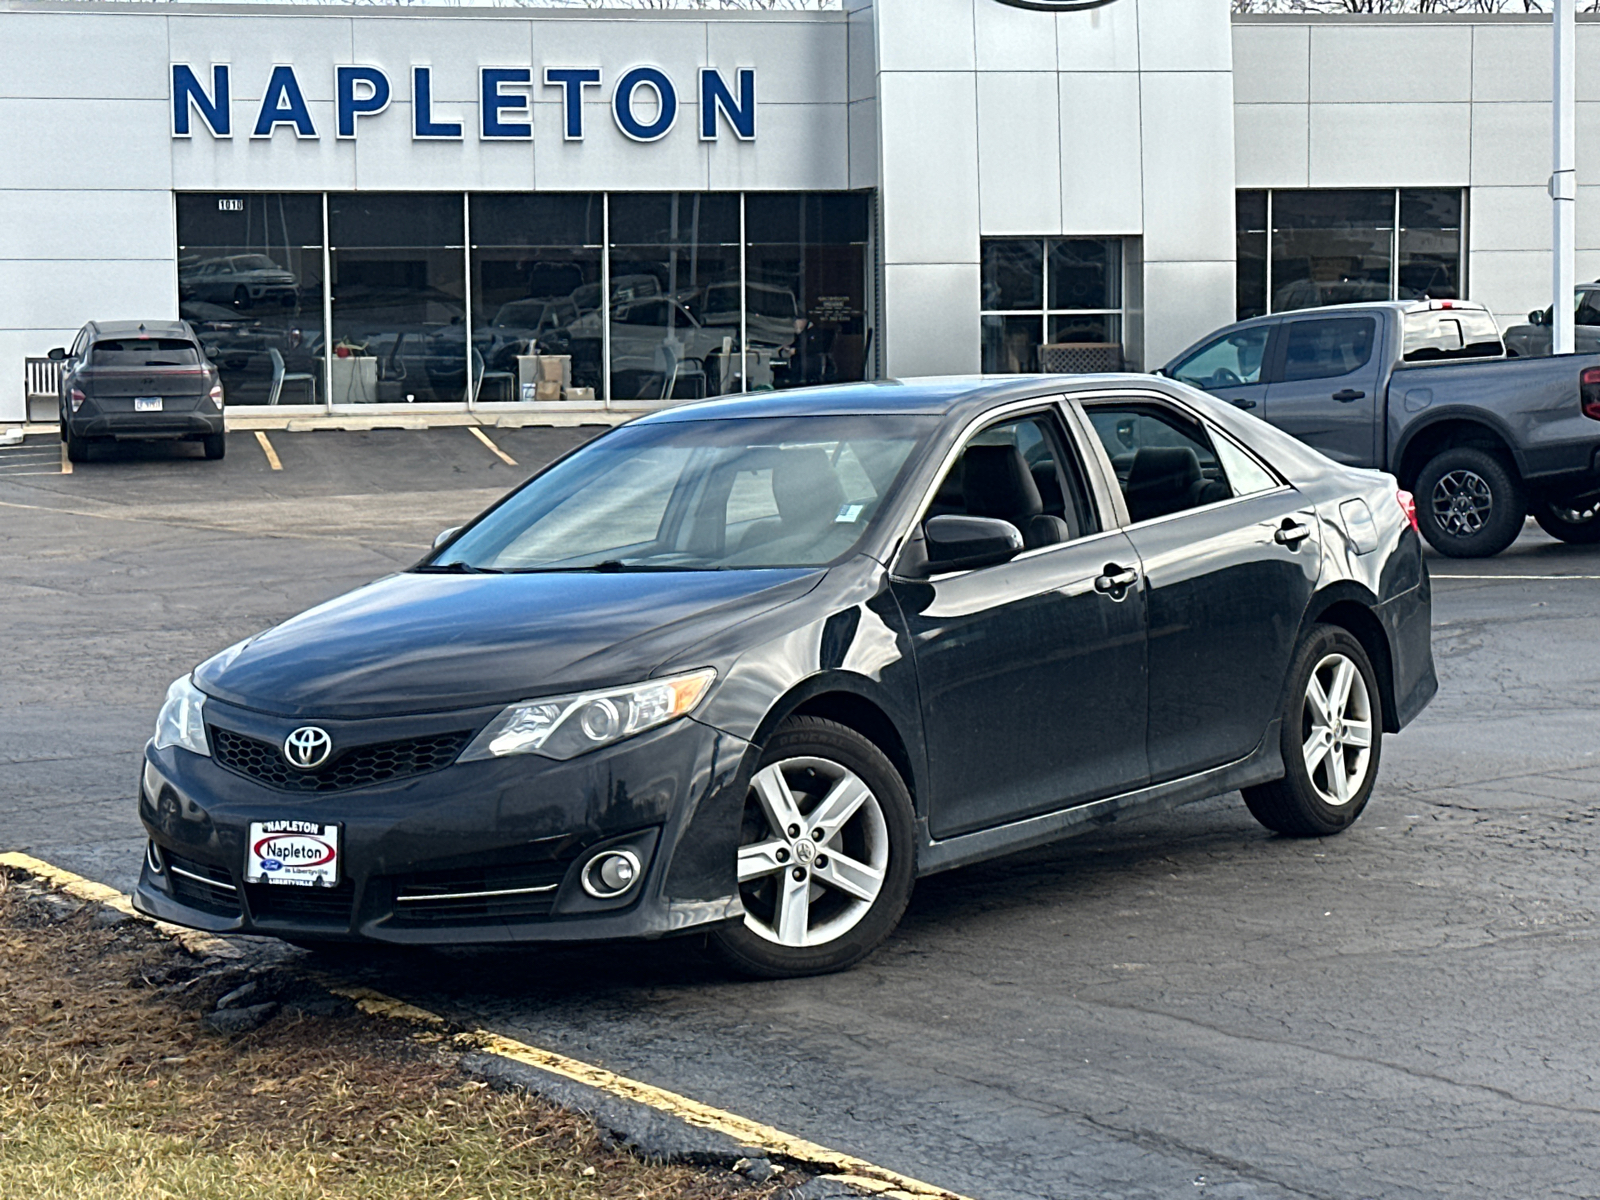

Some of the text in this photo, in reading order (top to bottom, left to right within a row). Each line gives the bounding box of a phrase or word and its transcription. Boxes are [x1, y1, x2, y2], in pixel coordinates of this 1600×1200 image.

[170, 63, 757, 143] NAPLETON
[219, 200, 243, 210] 1010
[266, 820, 319, 834] NAPLETON
[267, 842, 322, 861] Napleton
